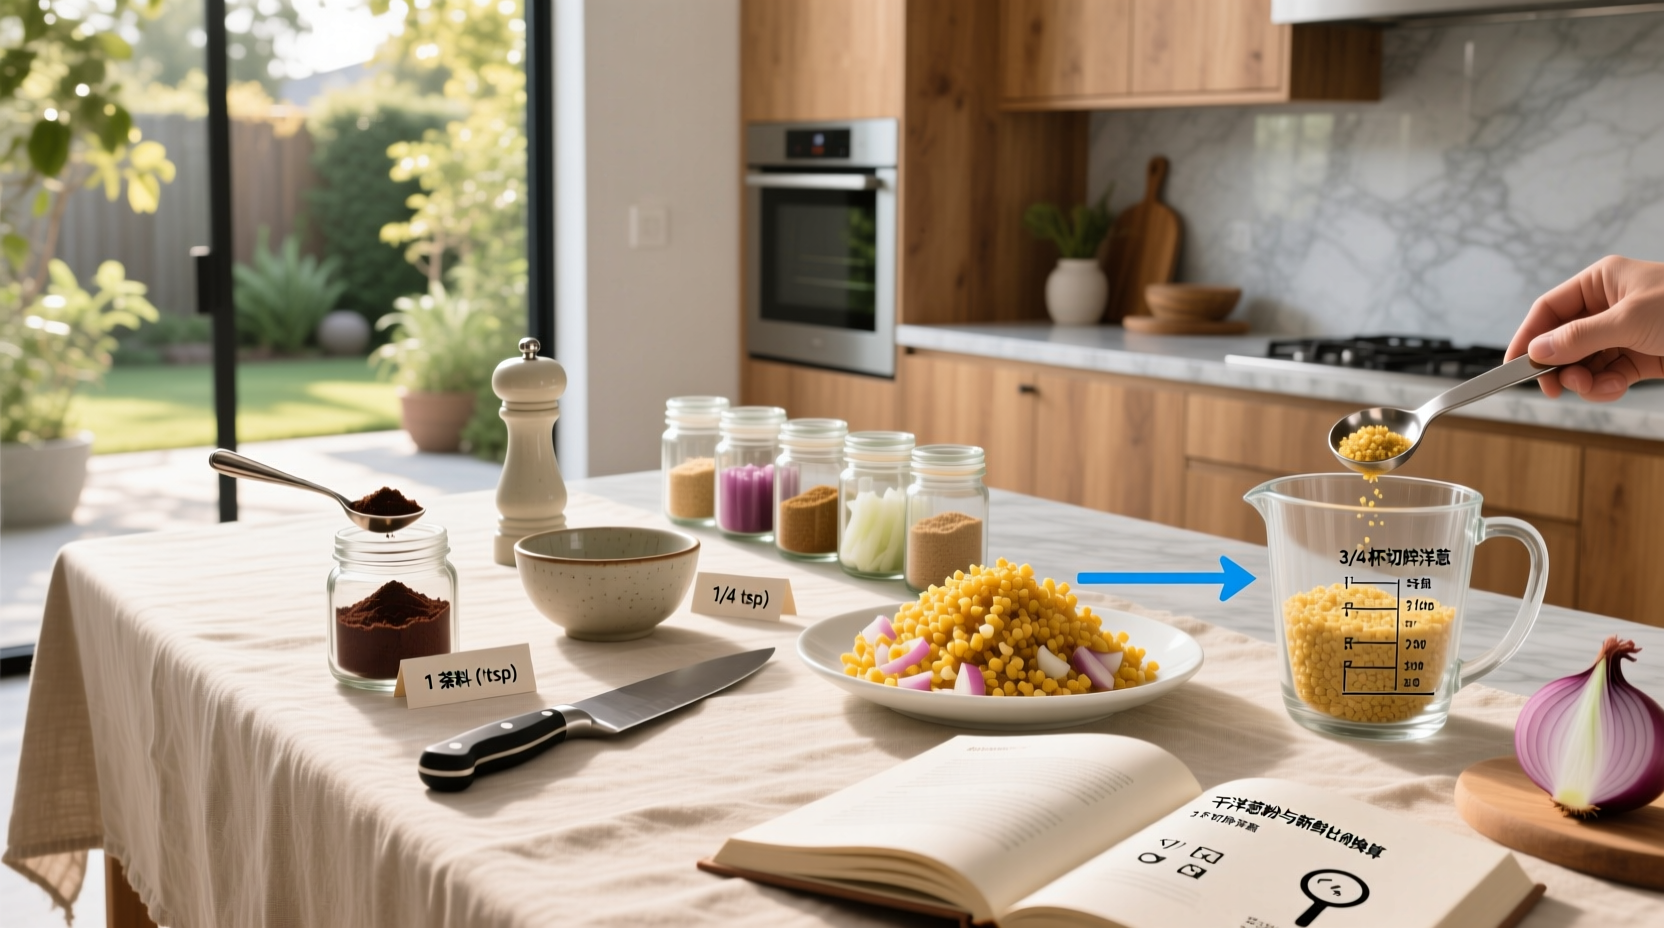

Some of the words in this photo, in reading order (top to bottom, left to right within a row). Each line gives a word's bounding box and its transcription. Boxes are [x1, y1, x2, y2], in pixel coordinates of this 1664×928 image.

[713, 585, 737, 605] 1/4
[741, 589, 769, 610] tsp)
[424, 674, 433, 690] 1
